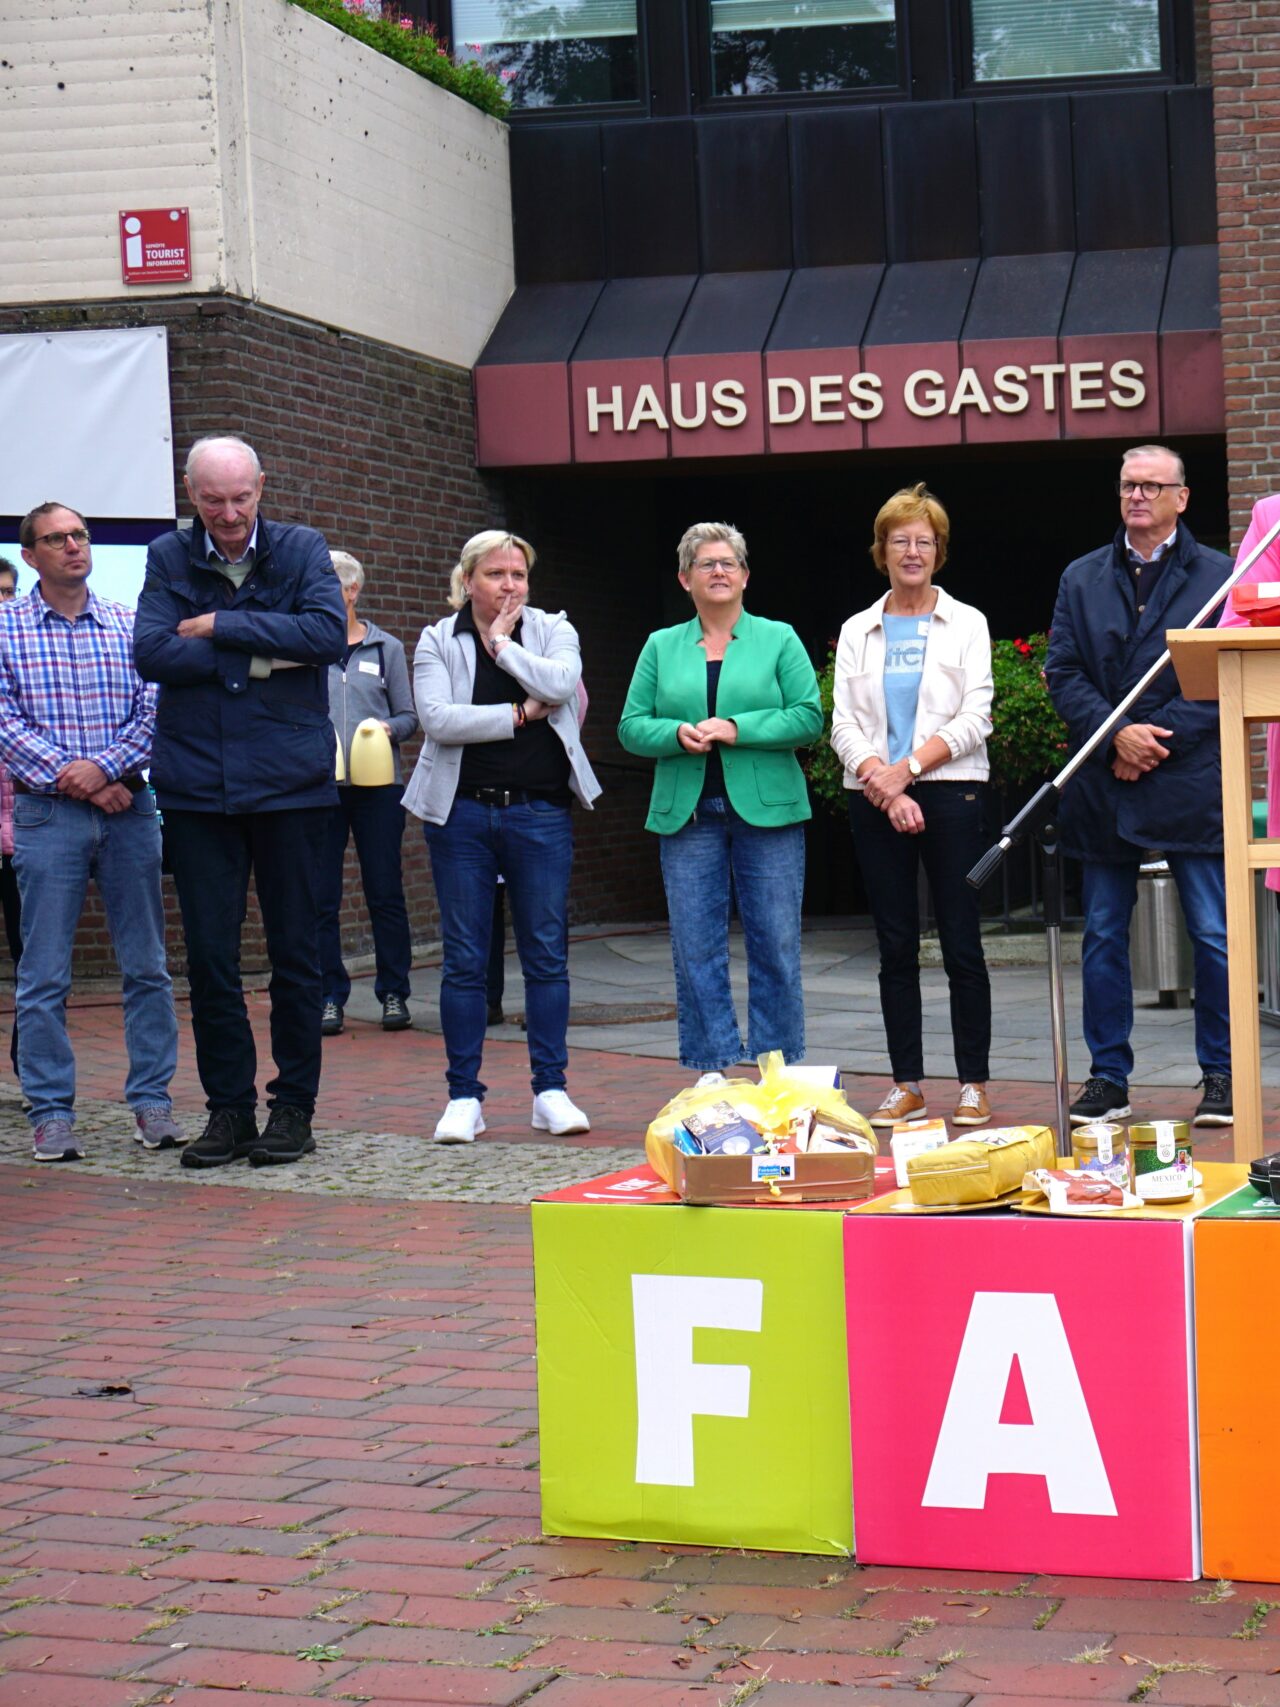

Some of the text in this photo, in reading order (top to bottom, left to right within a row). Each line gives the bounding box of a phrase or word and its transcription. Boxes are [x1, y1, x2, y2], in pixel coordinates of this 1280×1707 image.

[146, 249, 184, 259] TOURIST
[586, 359, 1147, 433] HAUS DES GASTES
[1152, 1174, 1182, 1182] MEXICO
